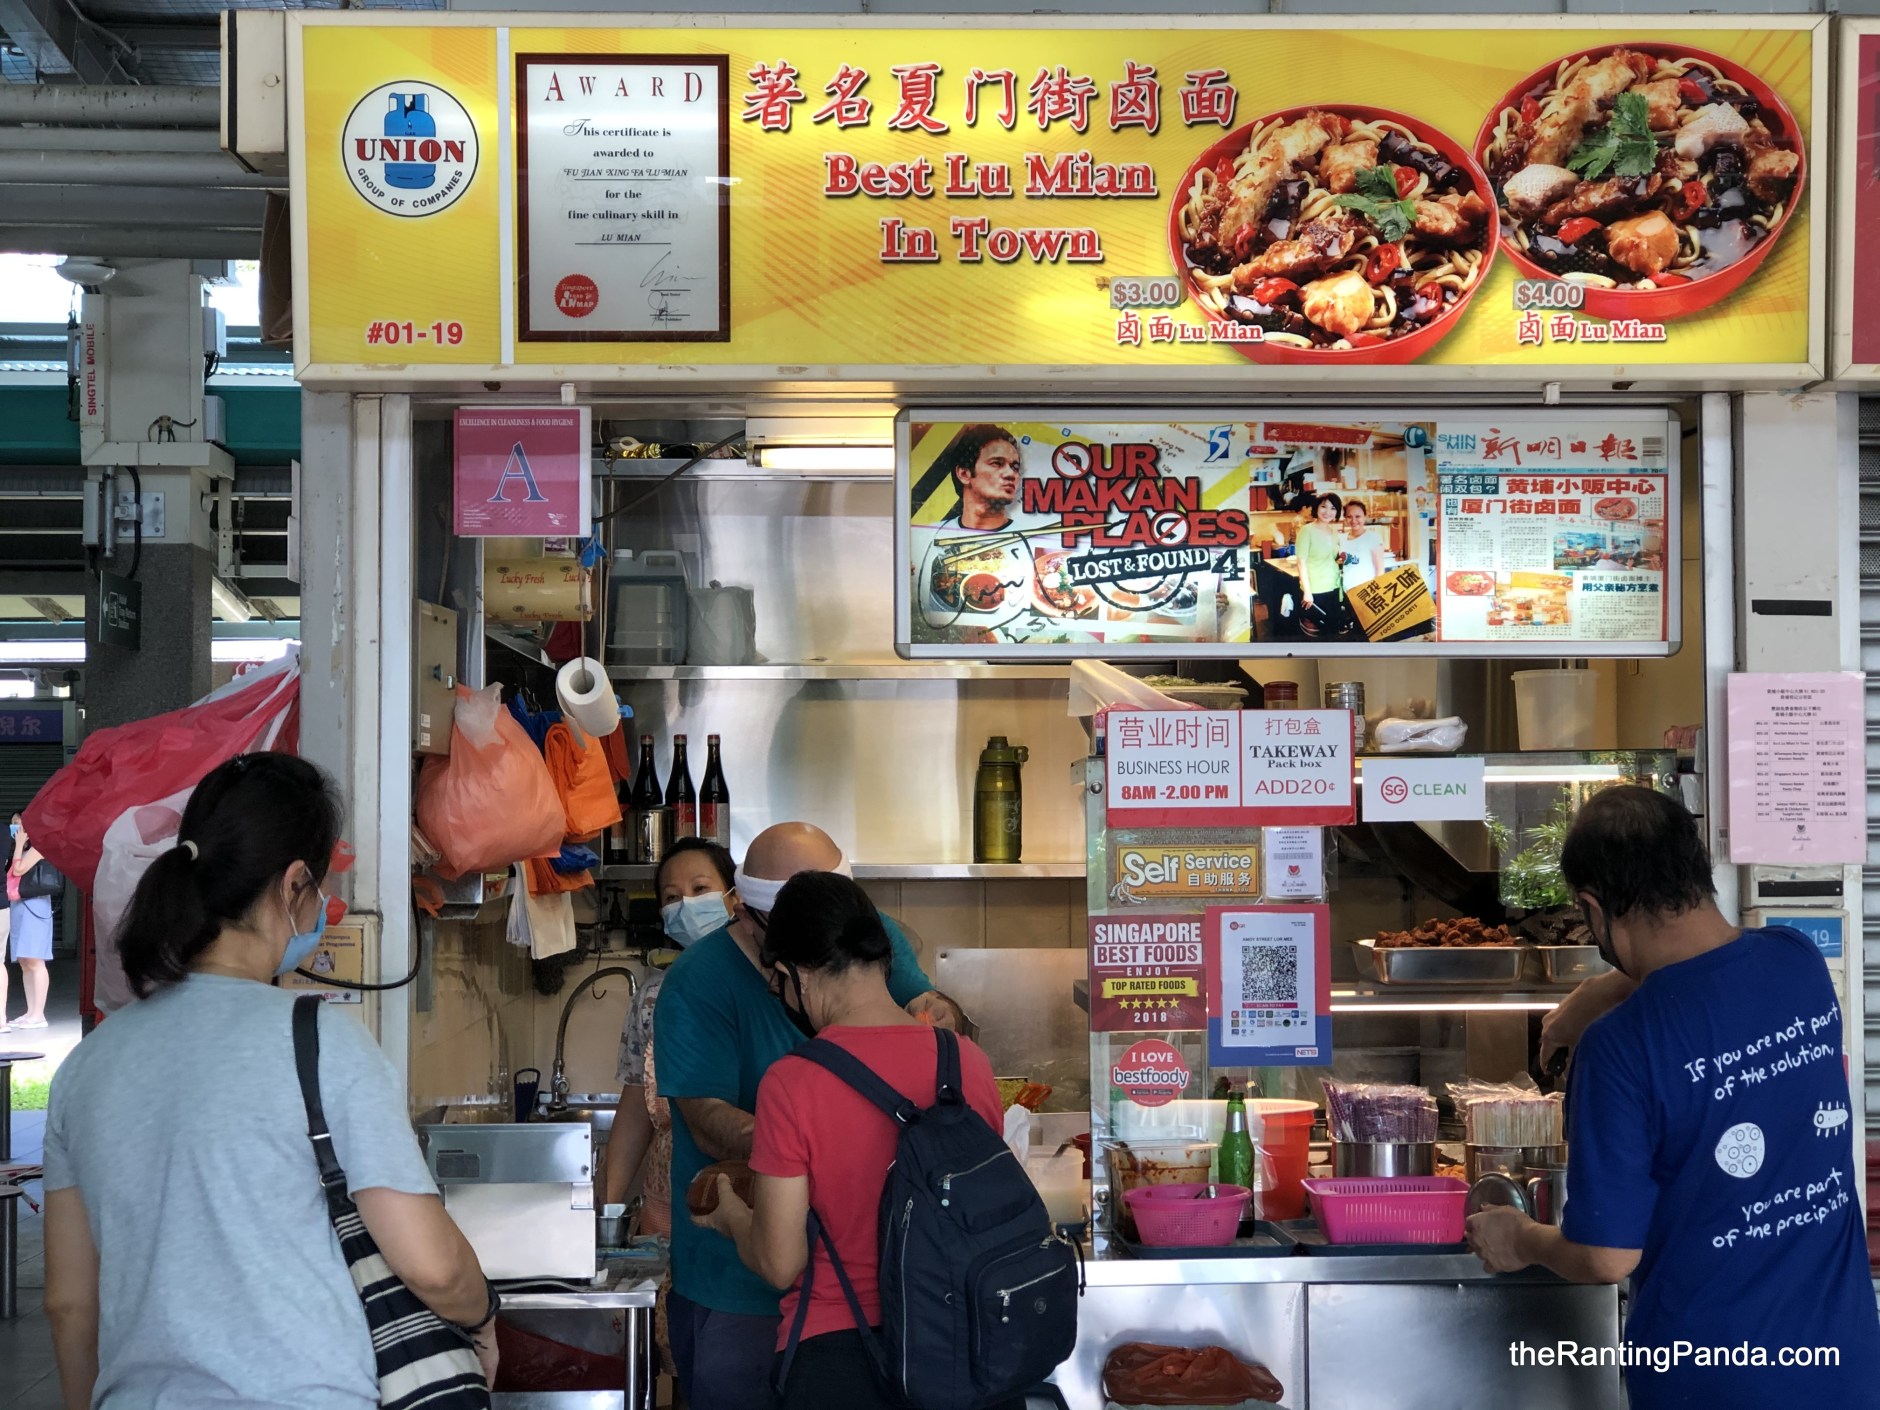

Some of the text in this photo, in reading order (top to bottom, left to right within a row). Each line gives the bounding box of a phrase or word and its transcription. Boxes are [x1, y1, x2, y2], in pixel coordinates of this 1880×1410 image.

[544, 71, 703, 102] AWARD
[742, 59, 1236, 132] 著名夏门街卤面
[563, 119, 671, 137] This certificate is
[355, 138, 466, 163] UNION
[593, 149, 654, 158] awarded to
[563, 169, 688, 177] FU JIAN XING FA LU MIAN
[825, 153, 1155, 195] Best Lu Mian
[358, 168, 463, 208] GROUP OF COMPANIES
[605, 190, 642, 199] for the
[568, 210, 679, 222] fine culinary skill in
[601, 234, 641, 242] LU MIAN
[881, 217, 1103, 260] In Town
[1114, 282, 1177, 303] $3.00
[1517, 283, 1581, 306] $4.00
[368, 322, 463, 345] #01-19
[1117, 312, 1173, 343] 卤面
[1179, 321, 1262, 339] Lu Mian
[1518, 311, 1575, 342] 卤面
[1580, 321, 1664, 339] Lu Mian
[86, 323, 97, 416] SINGTEL MOBILE
[459, 418, 491, 426] EXCELLENCE
[497, 418, 531, 426] CLEANLINESS
[536, 418, 551, 426] FOOD
[551, 418, 574, 426] HYGIENE
[1204, 424, 1233, 462] 5
[1438, 434, 1476, 442] SHIN
[1446, 442, 1476, 450] MIN
[1052, 442, 1161, 478] OUR
[487, 441, 549, 502] A
[1023, 477, 1199, 513] MAKAN
[1506, 479, 1656, 495] 黄埔小贩中心
[1461, 499, 1581, 515] 厦门街卤面
[1061, 510, 1249, 547] PLACES
[1211, 549, 1245, 581] 4
[501, 572, 545, 589] Lucky Fresh
[1119, 716, 1230, 749] 营业时间
[1265, 717, 1321, 736] 打包盒
[1249, 745, 1339, 758] TAKEWAY
[1117, 760, 1230, 775] BUSINESS HOUR
[1267, 759, 1322, 768] Pack box
[1121, 785, 1229, 800] 8AM -2.00 PM
[1385, 783, 1466, 796] SG CLEAN
[1124, 852, 1252, 887] Self Service
[1188, 872, 1252, 887] 自助服务
[1095, 922, 1201, 944] SINGAPORE
[1097, 944, 1198, 964] BEST FOODS
[1126, 966, 1170, 976] ENJOY
[1111, 980, 1186, 991] TOP RATED FOODS
[1134, 1012, 1167, 1023] 2018
[1685, 1002, 1839, 1083] If you are not part
[1131, 1052, 1173, 1063] I LOVE
[1114, 1067, 1188, 1088] bestfoody
[1714, 1043, 1834, 1100] of the solution,
[1742, 1167, 1843, 1222] you are part
[1712, 1228, 1740, 1248] of
